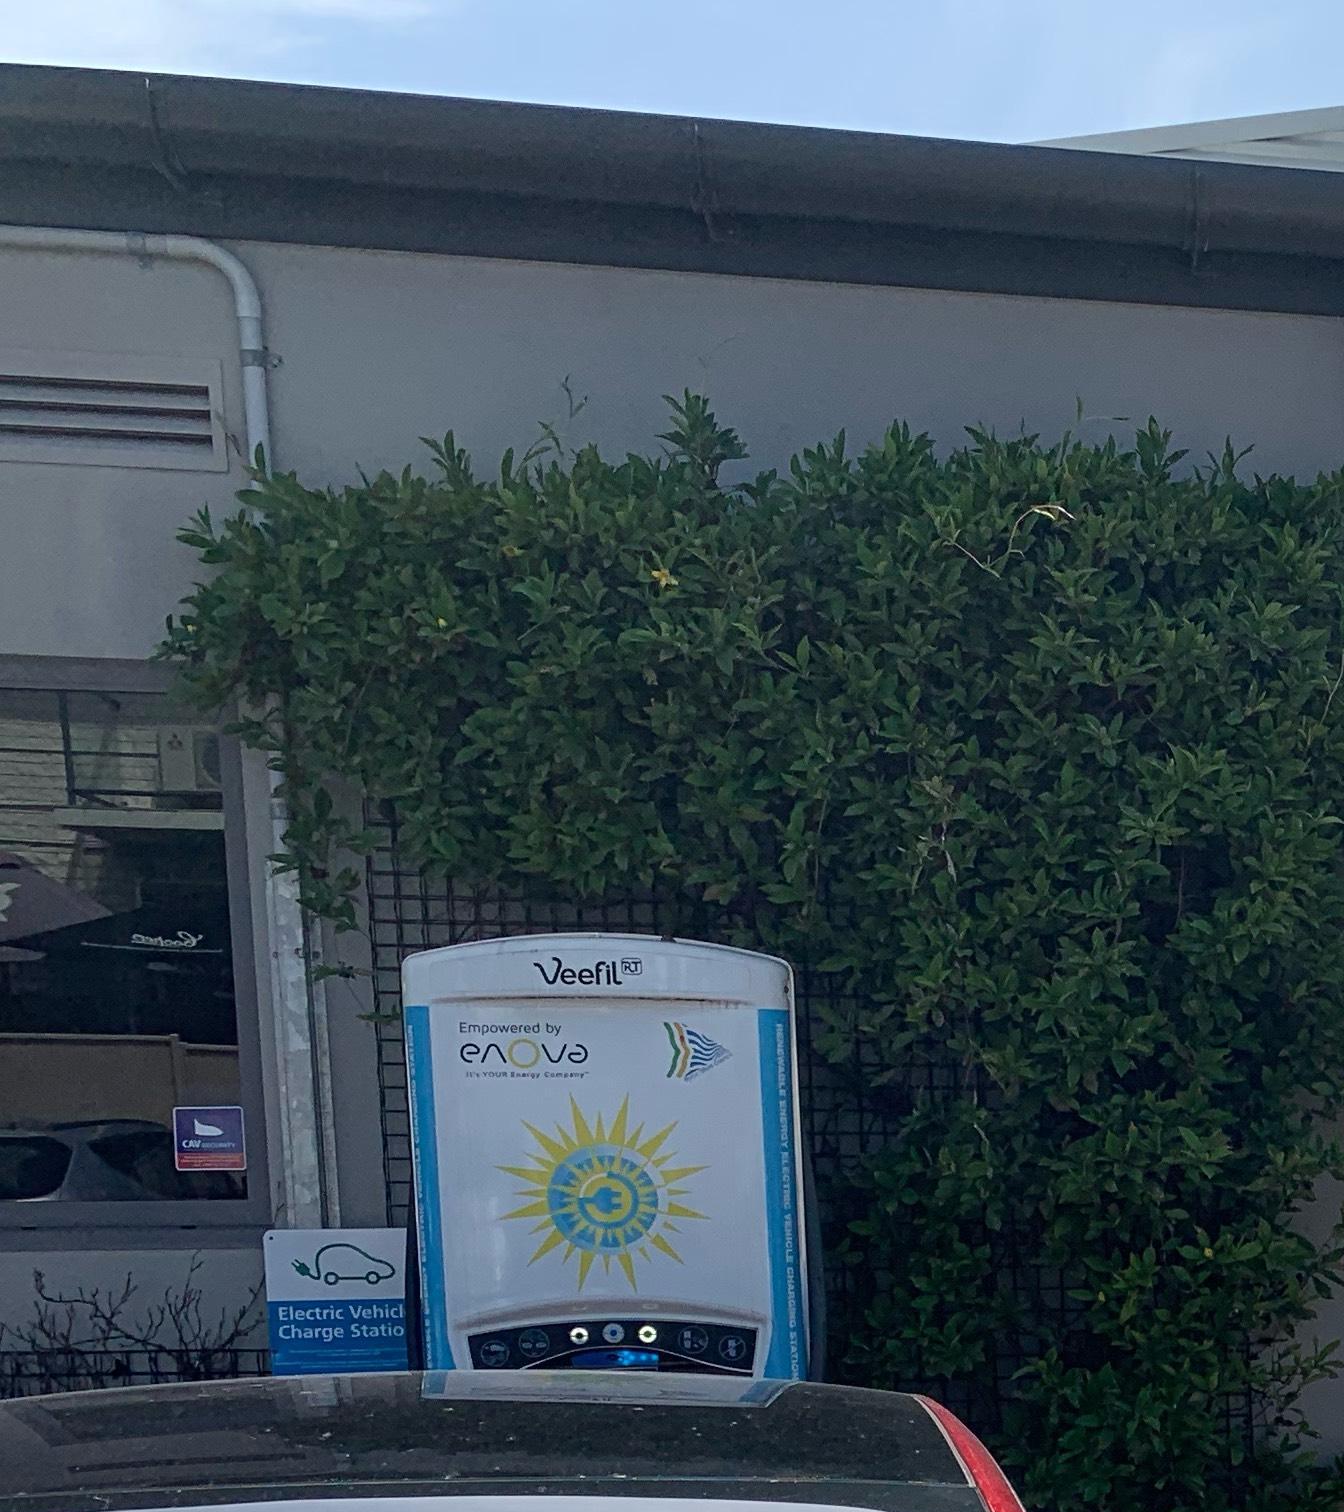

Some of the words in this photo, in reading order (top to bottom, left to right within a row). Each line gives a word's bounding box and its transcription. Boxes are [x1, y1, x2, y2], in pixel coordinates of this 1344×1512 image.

[533, 956, 623, 986] Veefil
[623, 959, 641, 974] RT
[459, 1022, 540, 1036] Empowered
[545, 1022, 562, 1036] by
[510, 1071, 540, 1079] Energy
[776, 1024, 787, 1097] RENEWABLE
[778, 1100, 789, 1148] ENERGY
[781, 1152, 792, 1210] ELECTRIC
[784, 1213, 794, 1264] VEHICLE
[278, 1305, 344, 1321] Electric
[349, 1303, 405, 1319] Vehicl
[786, 1266, 797, 1328] CHARGING
[278, 1325, 344, 1342] Charge
[351, 1323, 405, 1337] Statio
